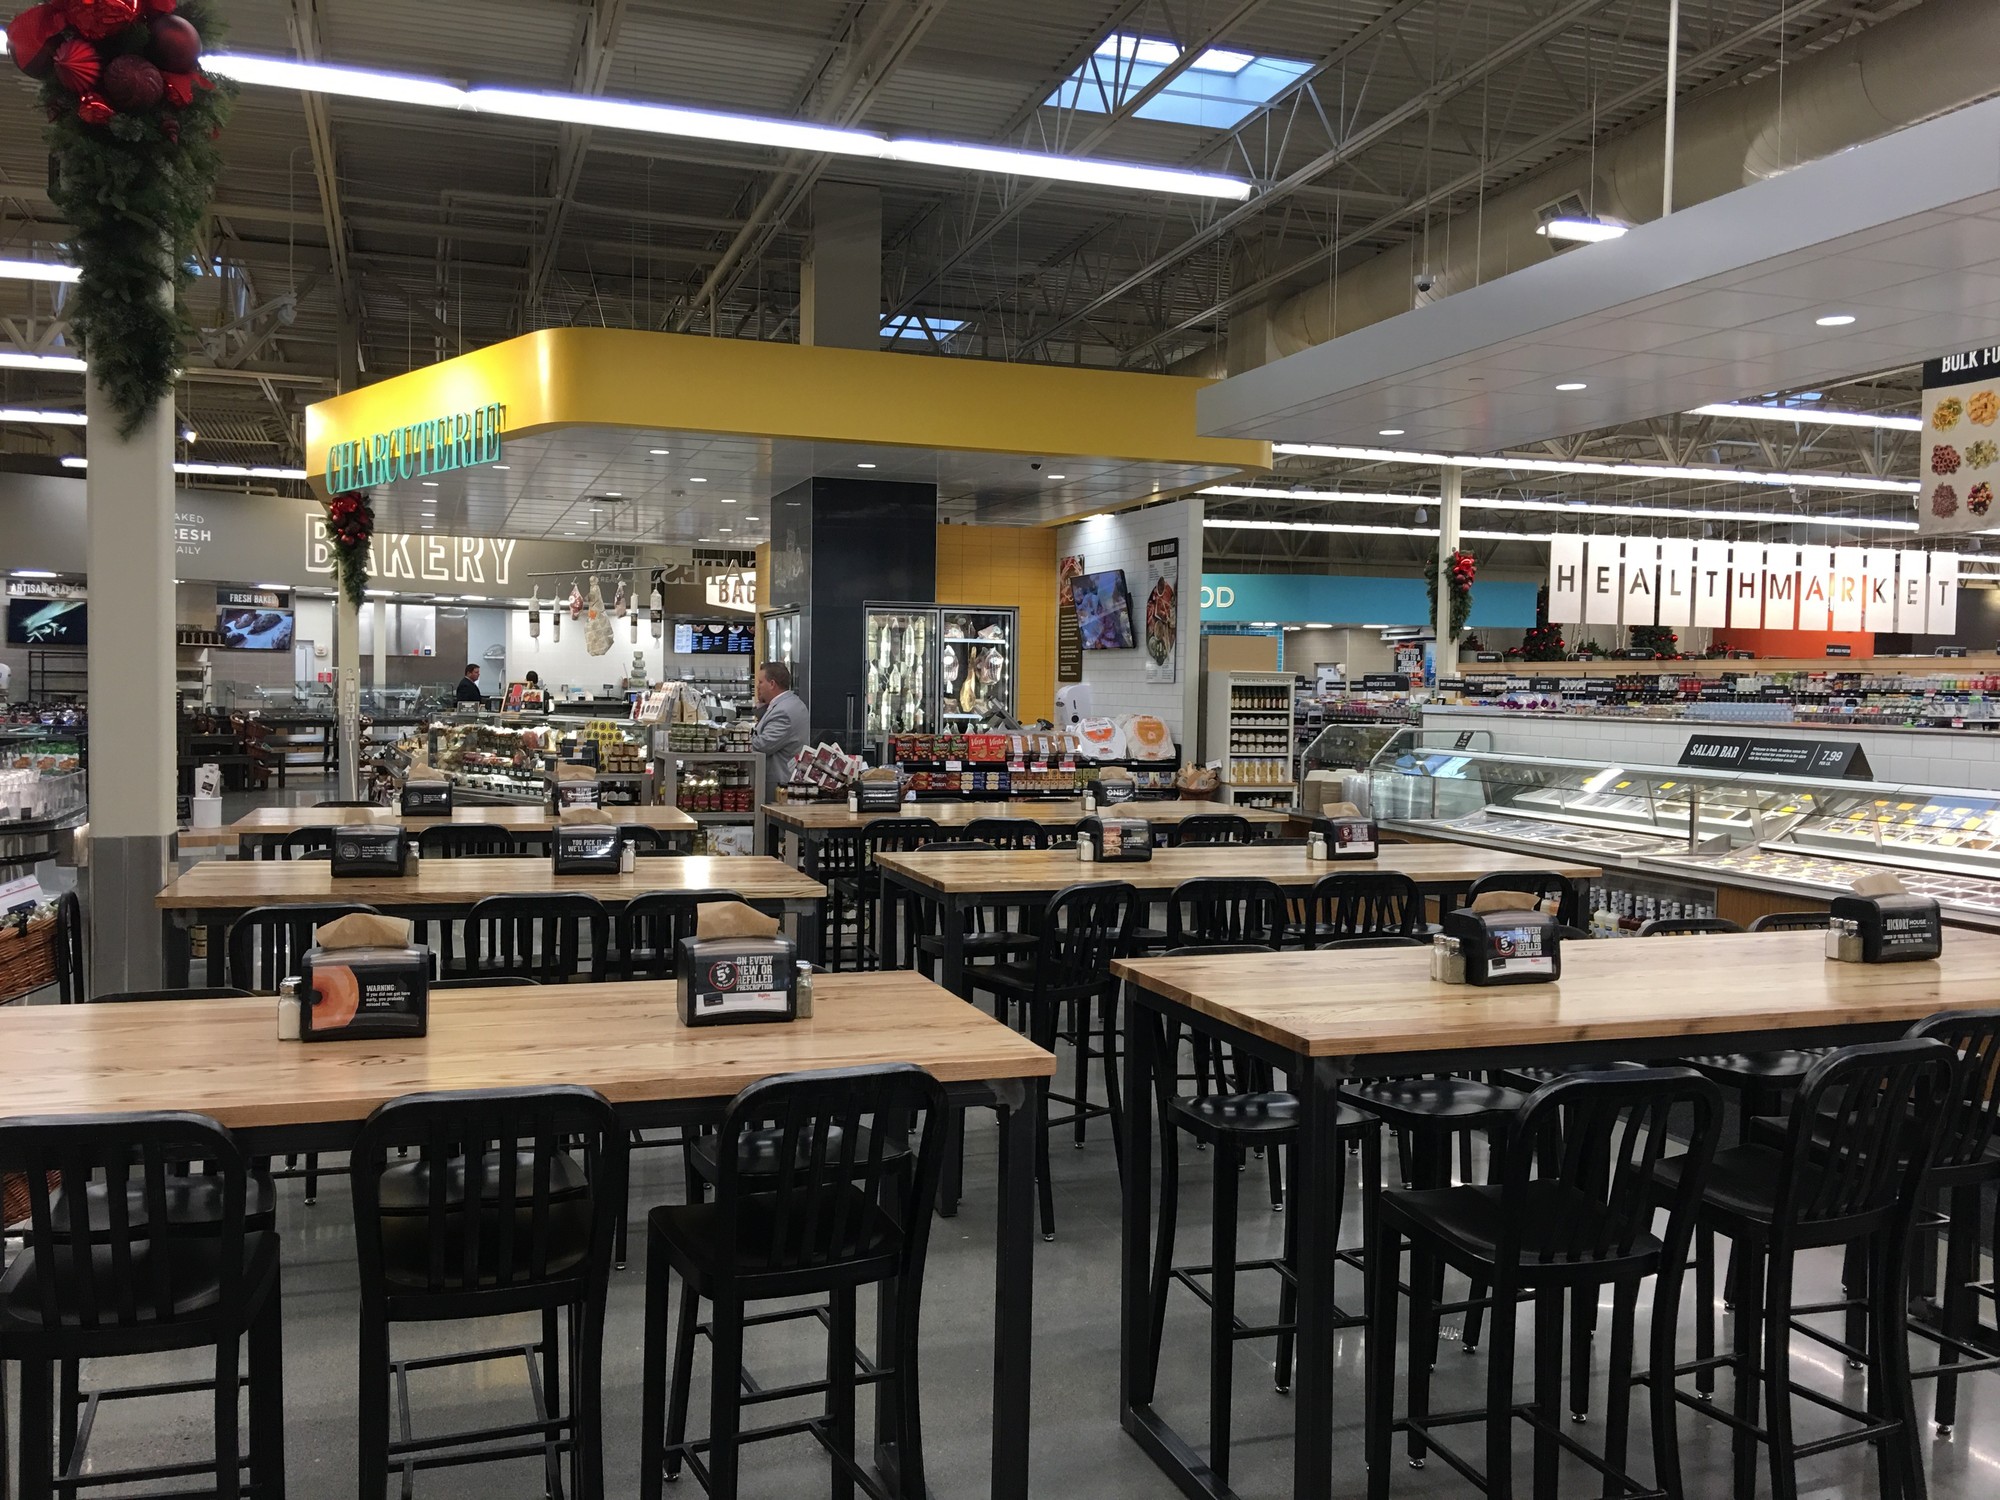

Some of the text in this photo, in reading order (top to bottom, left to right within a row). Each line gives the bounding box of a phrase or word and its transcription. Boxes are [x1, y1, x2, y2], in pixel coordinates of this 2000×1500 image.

[1942, 350, 1978, 373] BULK
[325, 402, 501, 495] CHARCUTERIE
[175, 513, 204, 524] AKED
[174, 528, 211, 542] ESH
[176, 546, 200, 554] AILY
[305, 513, 516, 584] BKERY
[11, 583, 47, 594] ARTISAN
[1557, 564, 1949, 606] HEALTHMARKET
[718, 580, 756, 603] BAG
[1200, 586, 1235, 608] OD
[230, 593, 252, 603] FRESH
[1690, 744, 1740, 758] SALAD BAR
[1822, 751, 1843, 761] 7.99
[1887, 918, 1909, 930] HICKORY
[1516, 934, 1541, 943] NEW OR
[1516, 943, 1542, 951] REFILLED
[736, 956, 773, 965] ON EVERY
[737, 965, 758, 975] NEW
[761, 965, 772, 974] OR
[737, 975, 773, 984] REFILLED
[366, 984, 396, 992] WARNING:
